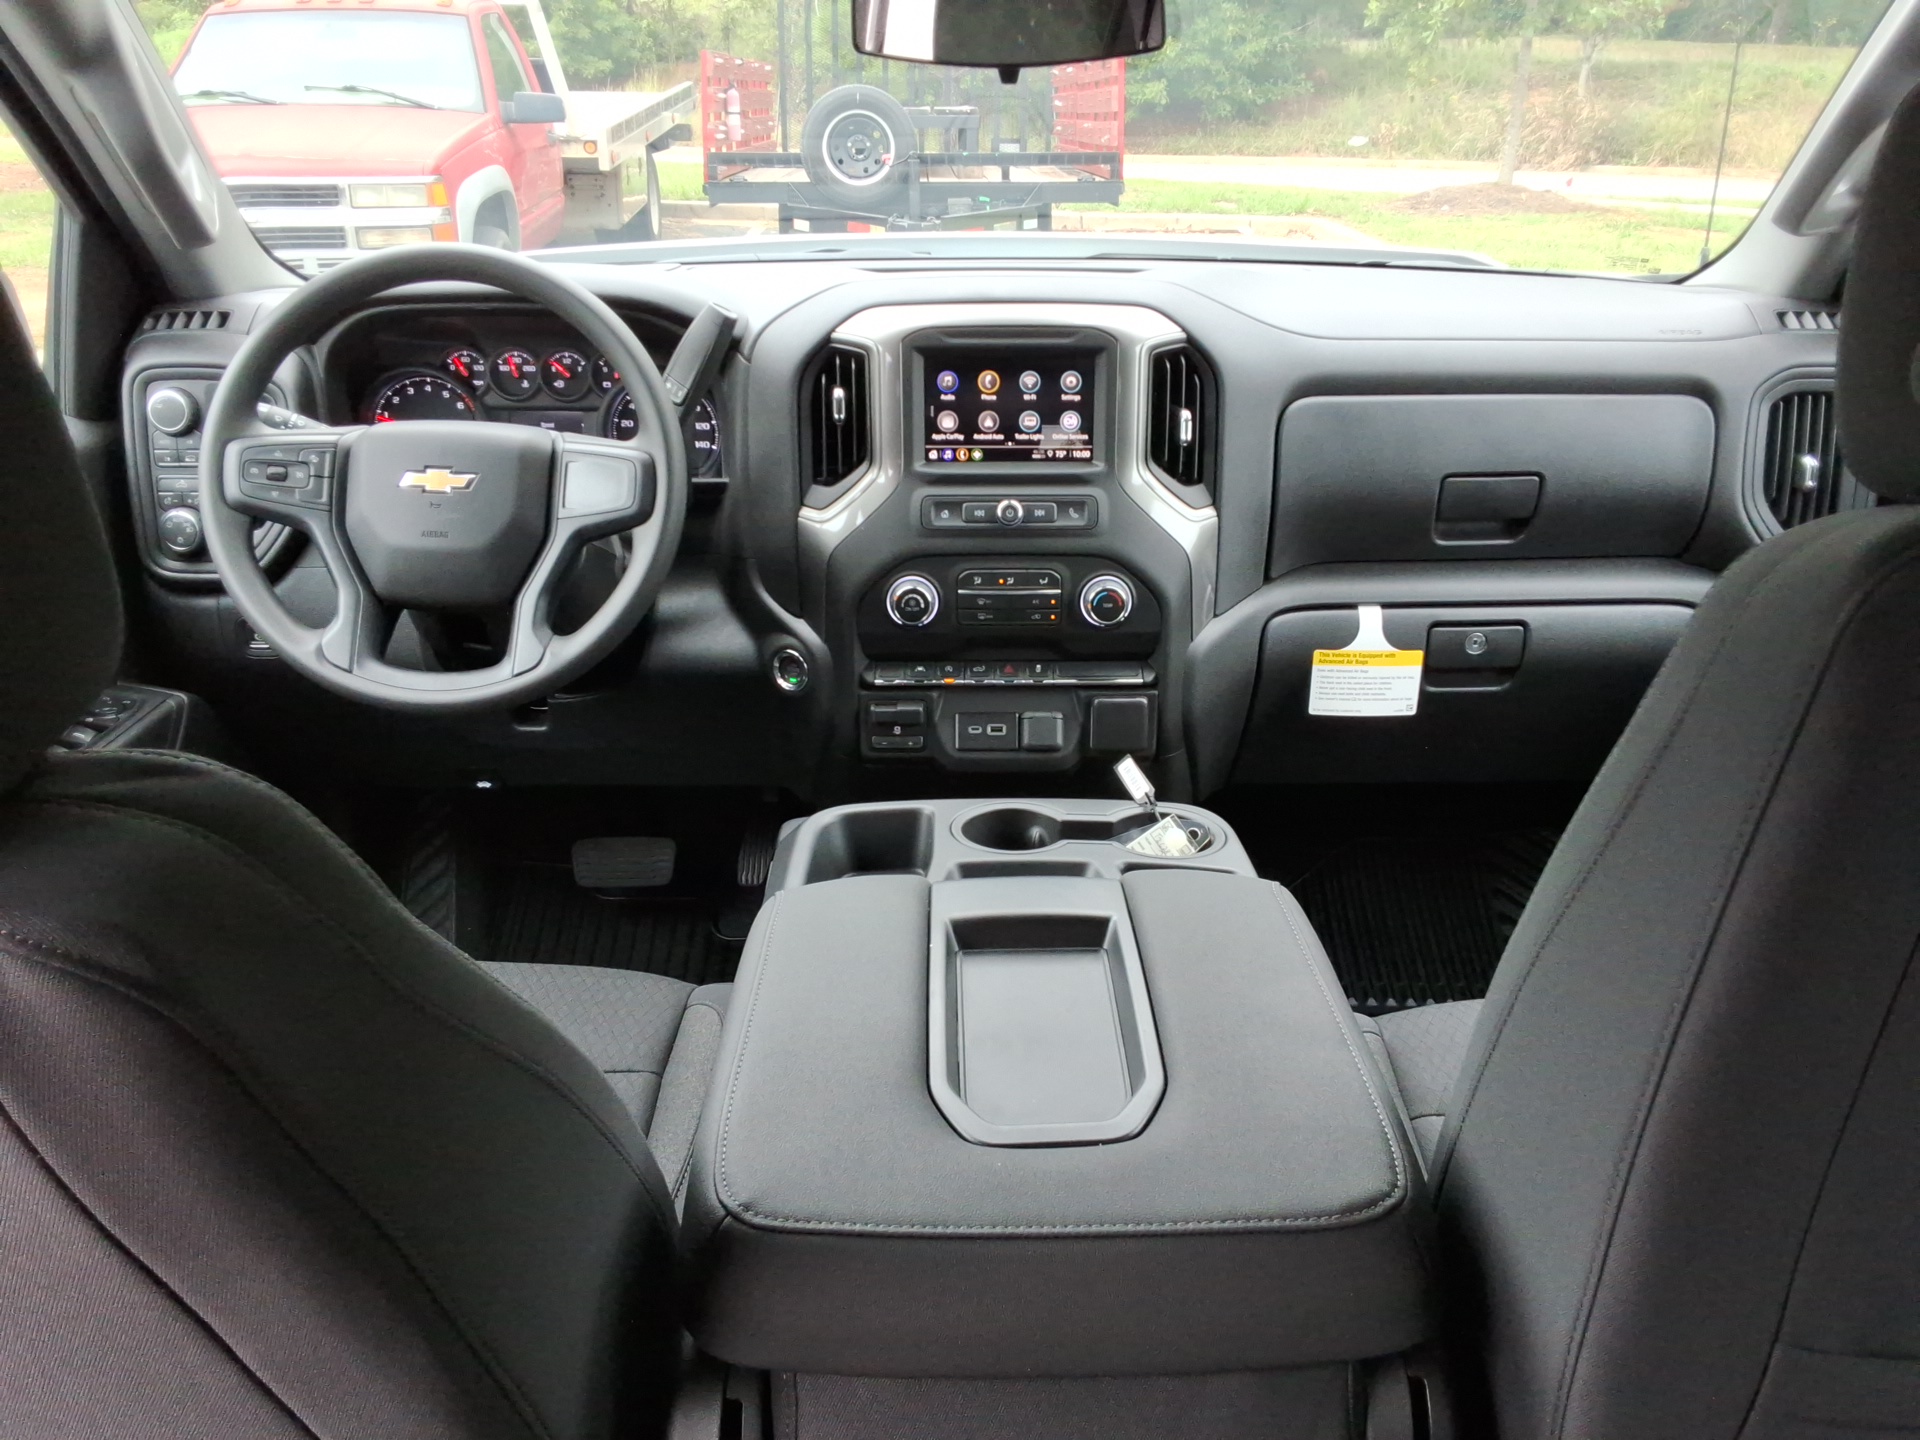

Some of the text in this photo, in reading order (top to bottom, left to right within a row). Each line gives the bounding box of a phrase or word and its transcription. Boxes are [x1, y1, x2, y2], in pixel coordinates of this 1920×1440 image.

[406, 387, 414, 395] 3
[392, 396, 400, 404] 2
[456, 402, 465, 410] 6
[620, 419, 634, 428] 20
[694, 422, 711, 431] 120
[694, 440, 711, 449] 140
[1072, 449, 1091, 458] 10:00
